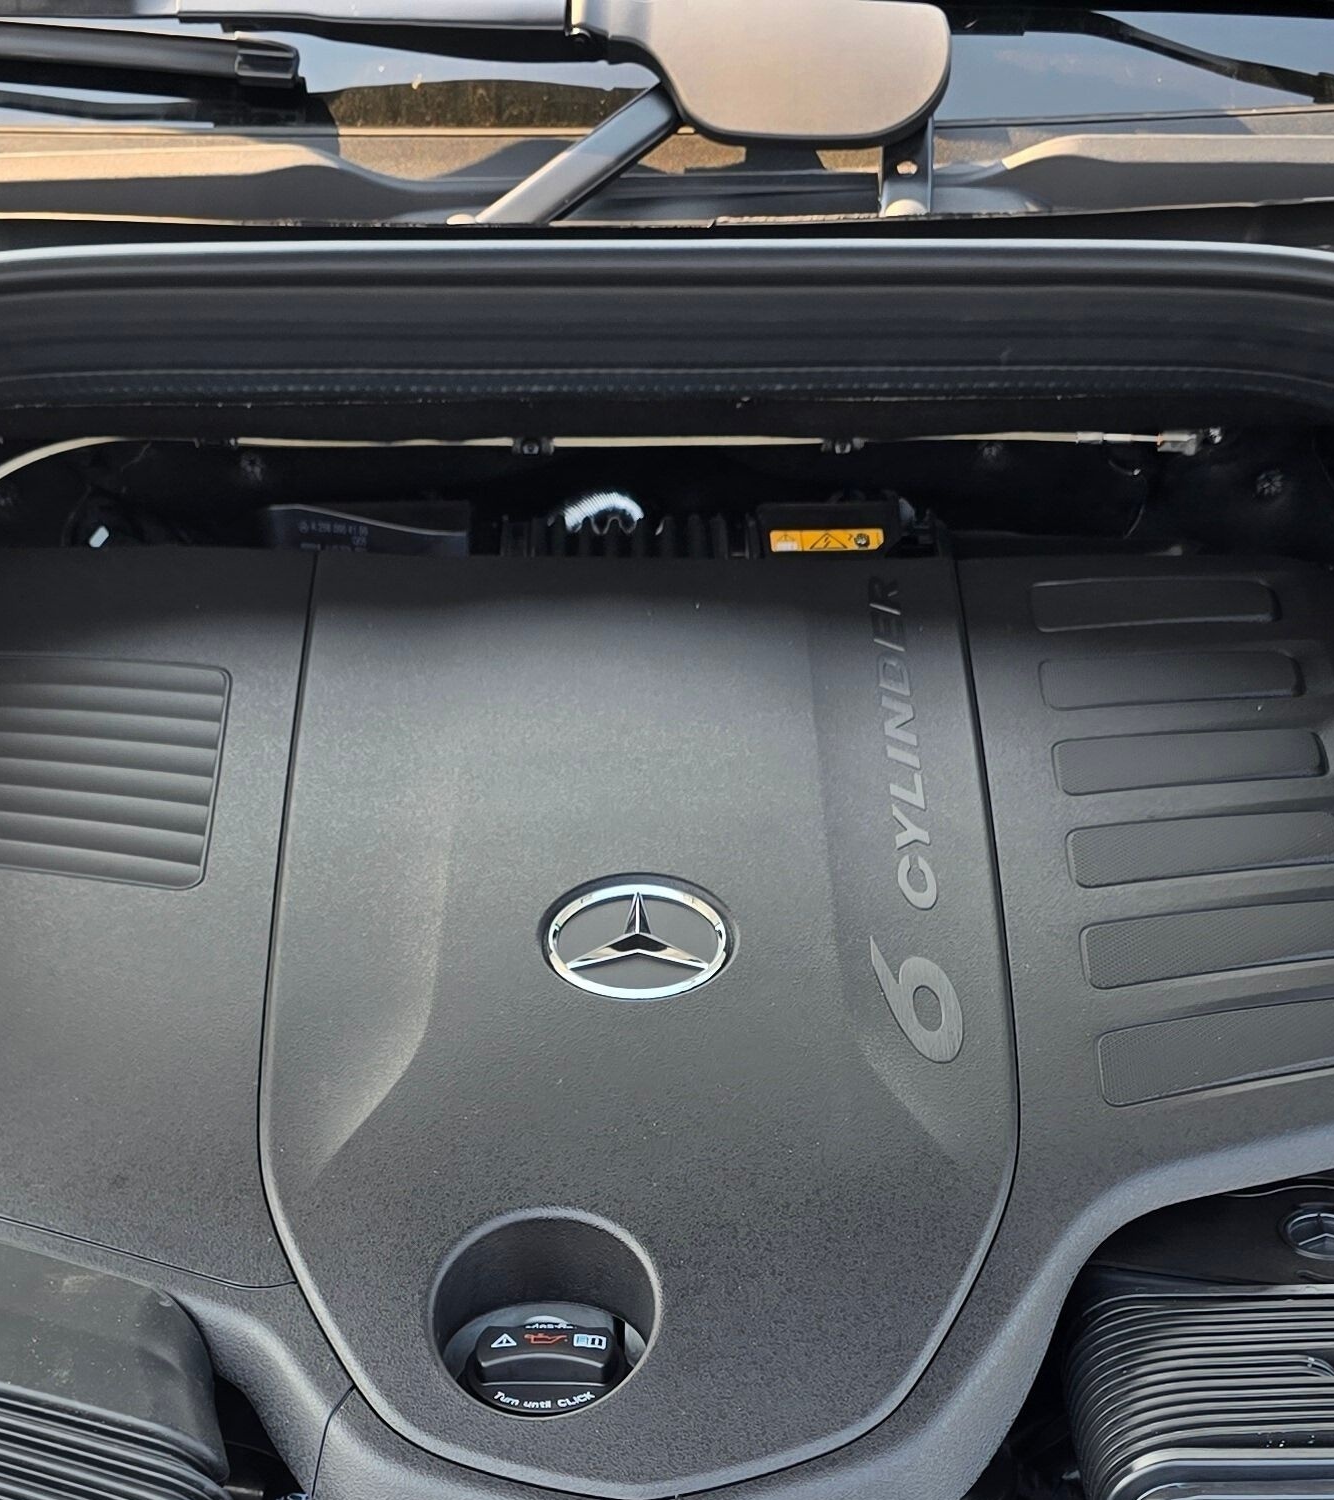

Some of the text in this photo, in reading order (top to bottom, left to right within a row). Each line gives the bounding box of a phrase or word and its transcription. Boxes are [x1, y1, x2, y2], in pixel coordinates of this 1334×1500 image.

[868, 576, 963, 1064] 6 CYLINDER
[494, 1391, 595, 1408] Turn until CLICK
